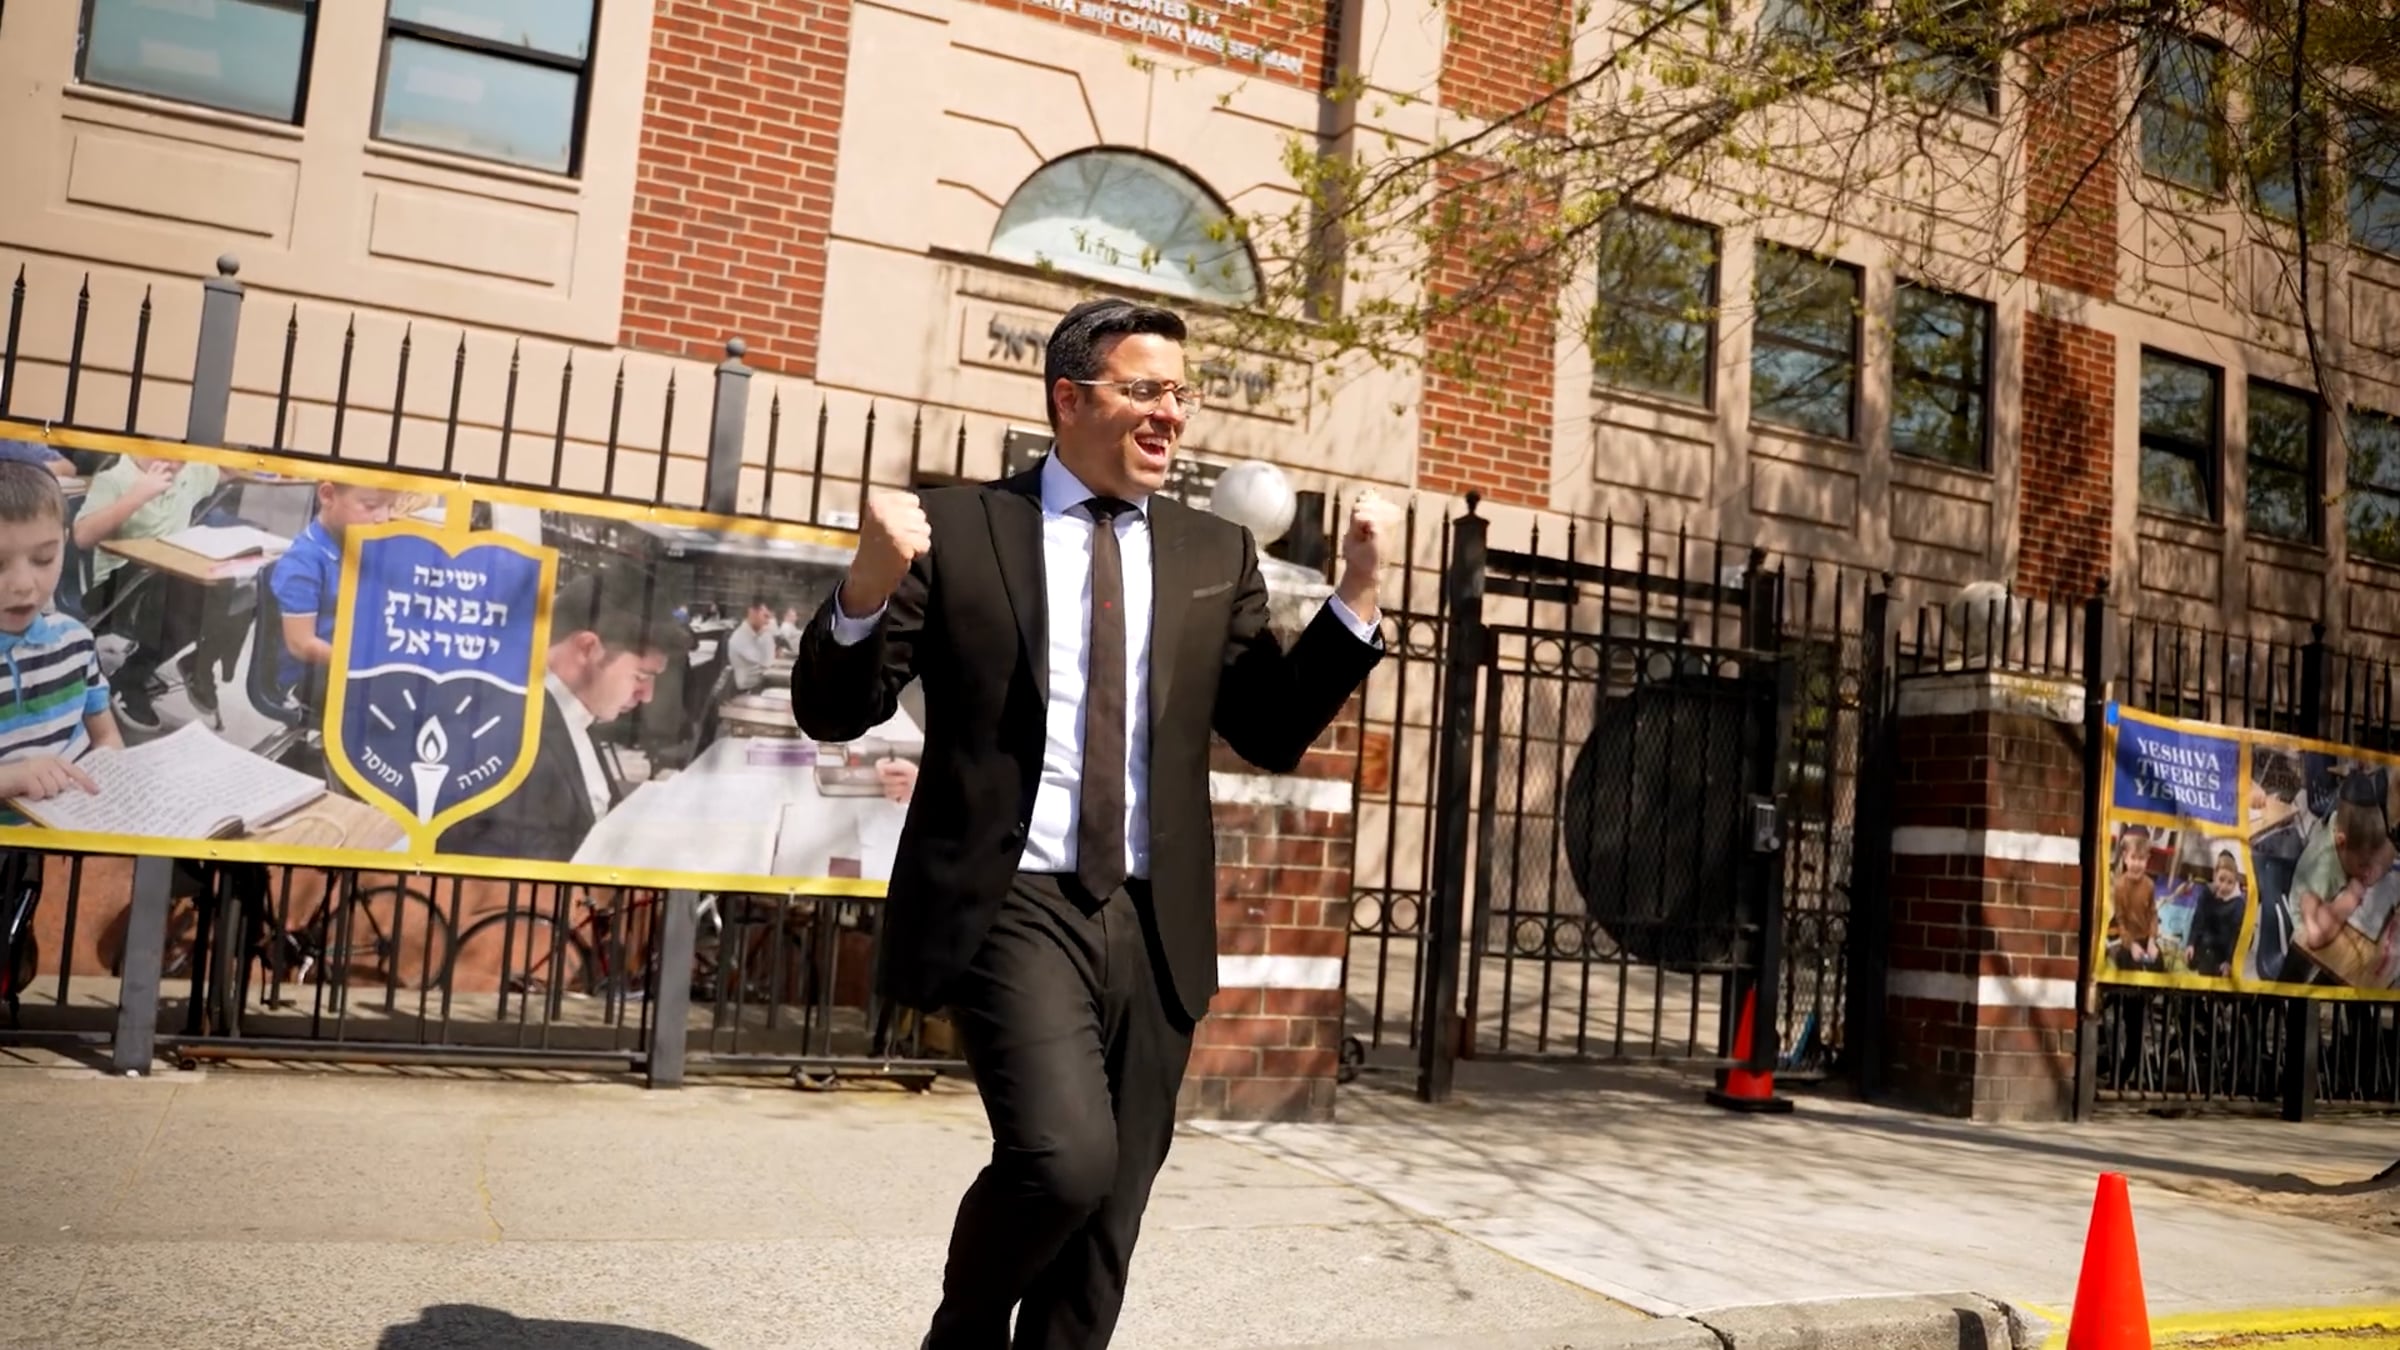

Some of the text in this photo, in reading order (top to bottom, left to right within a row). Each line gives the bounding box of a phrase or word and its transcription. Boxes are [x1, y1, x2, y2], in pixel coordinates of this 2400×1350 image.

[1079, 3, 1115, 23] and
[1118, 8, 1182, 40] CHAYA
[413, 564, 487, 592] ישיבה
[384, 590, 508, 627] תפארת
[385, 614, 501, 660] ישראל
[361, 746, 503, 790] תורה ומוסר
[2136, 736, 2220, 772] YESHIVA
[2137, 757, 2220, 791] TIFERES
[2134, 778, 2222, 811] YISROEL
